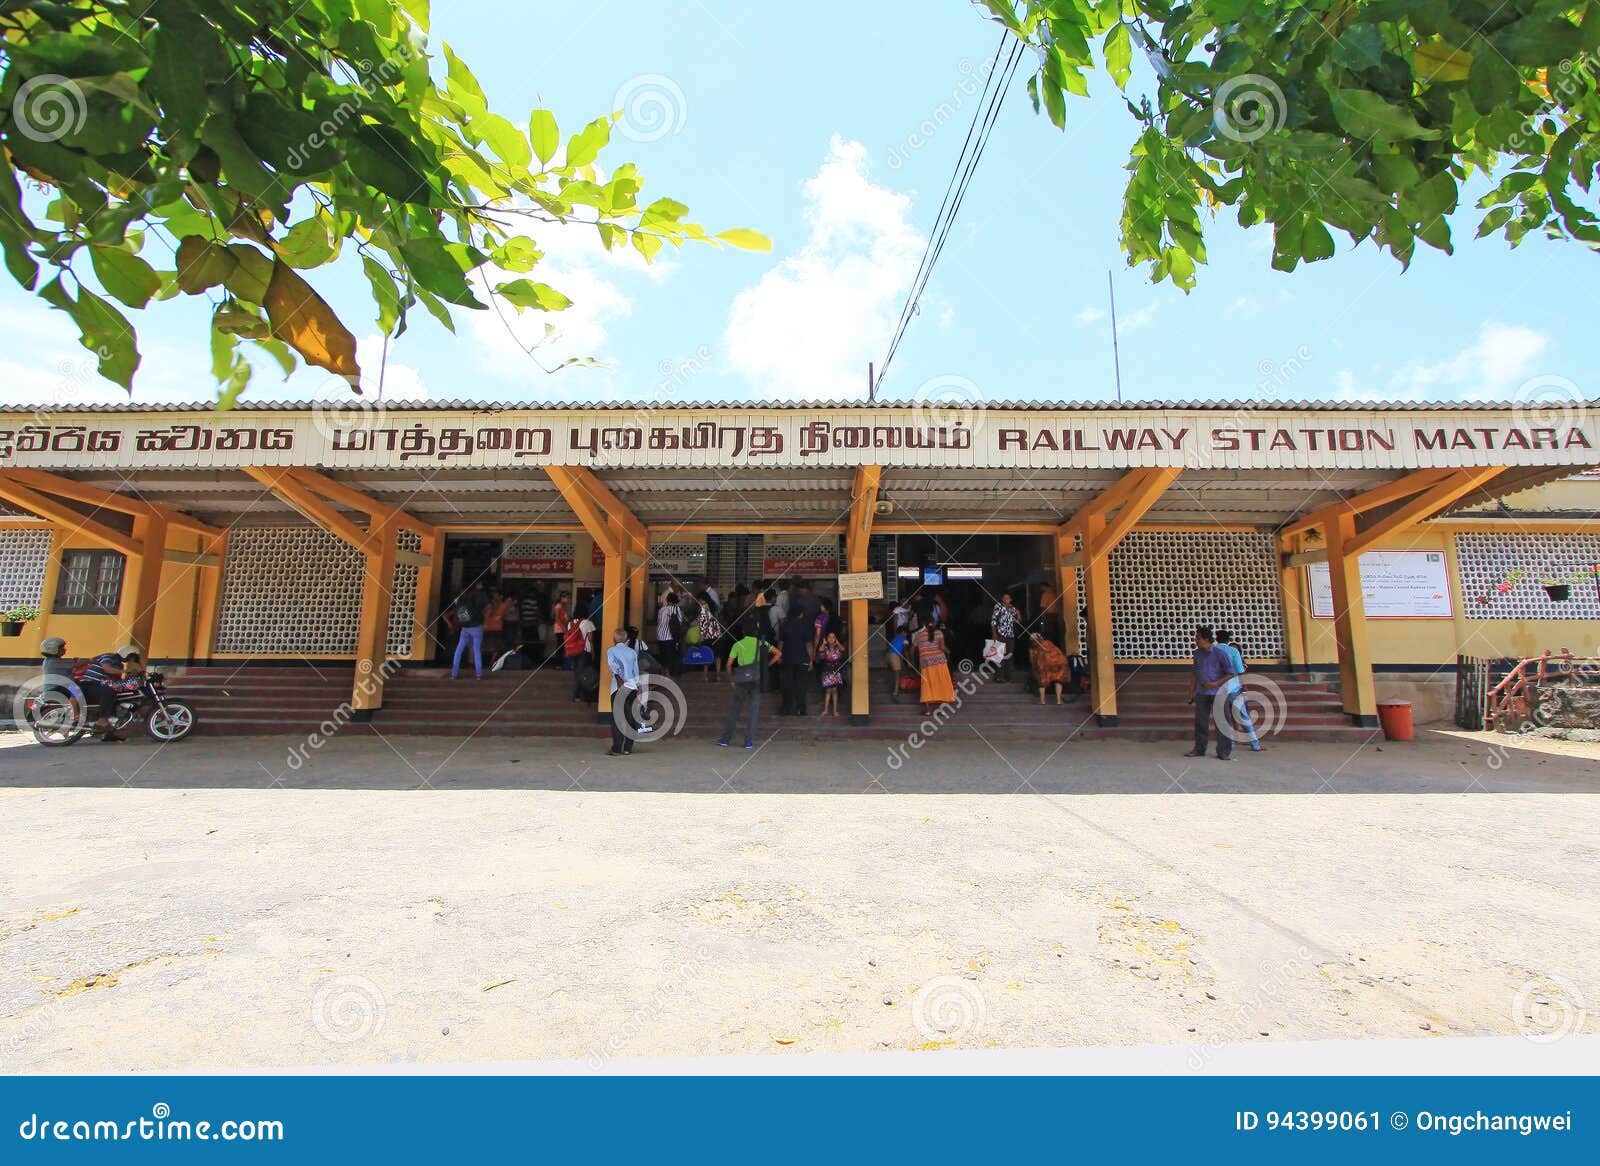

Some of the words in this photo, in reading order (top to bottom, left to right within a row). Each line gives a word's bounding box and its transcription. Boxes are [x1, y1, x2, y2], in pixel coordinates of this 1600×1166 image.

[332, 424, 552, 460] மாத்தறை
[570, 422, 785, 457] புகையிரத
[799, 421, 972, 456] நிலையம்
[998, 428, 1189, 451] RAILWAY
[1211, 428, 1395, 451] STATION
[1413, 428, 1592, 450] MATARA
